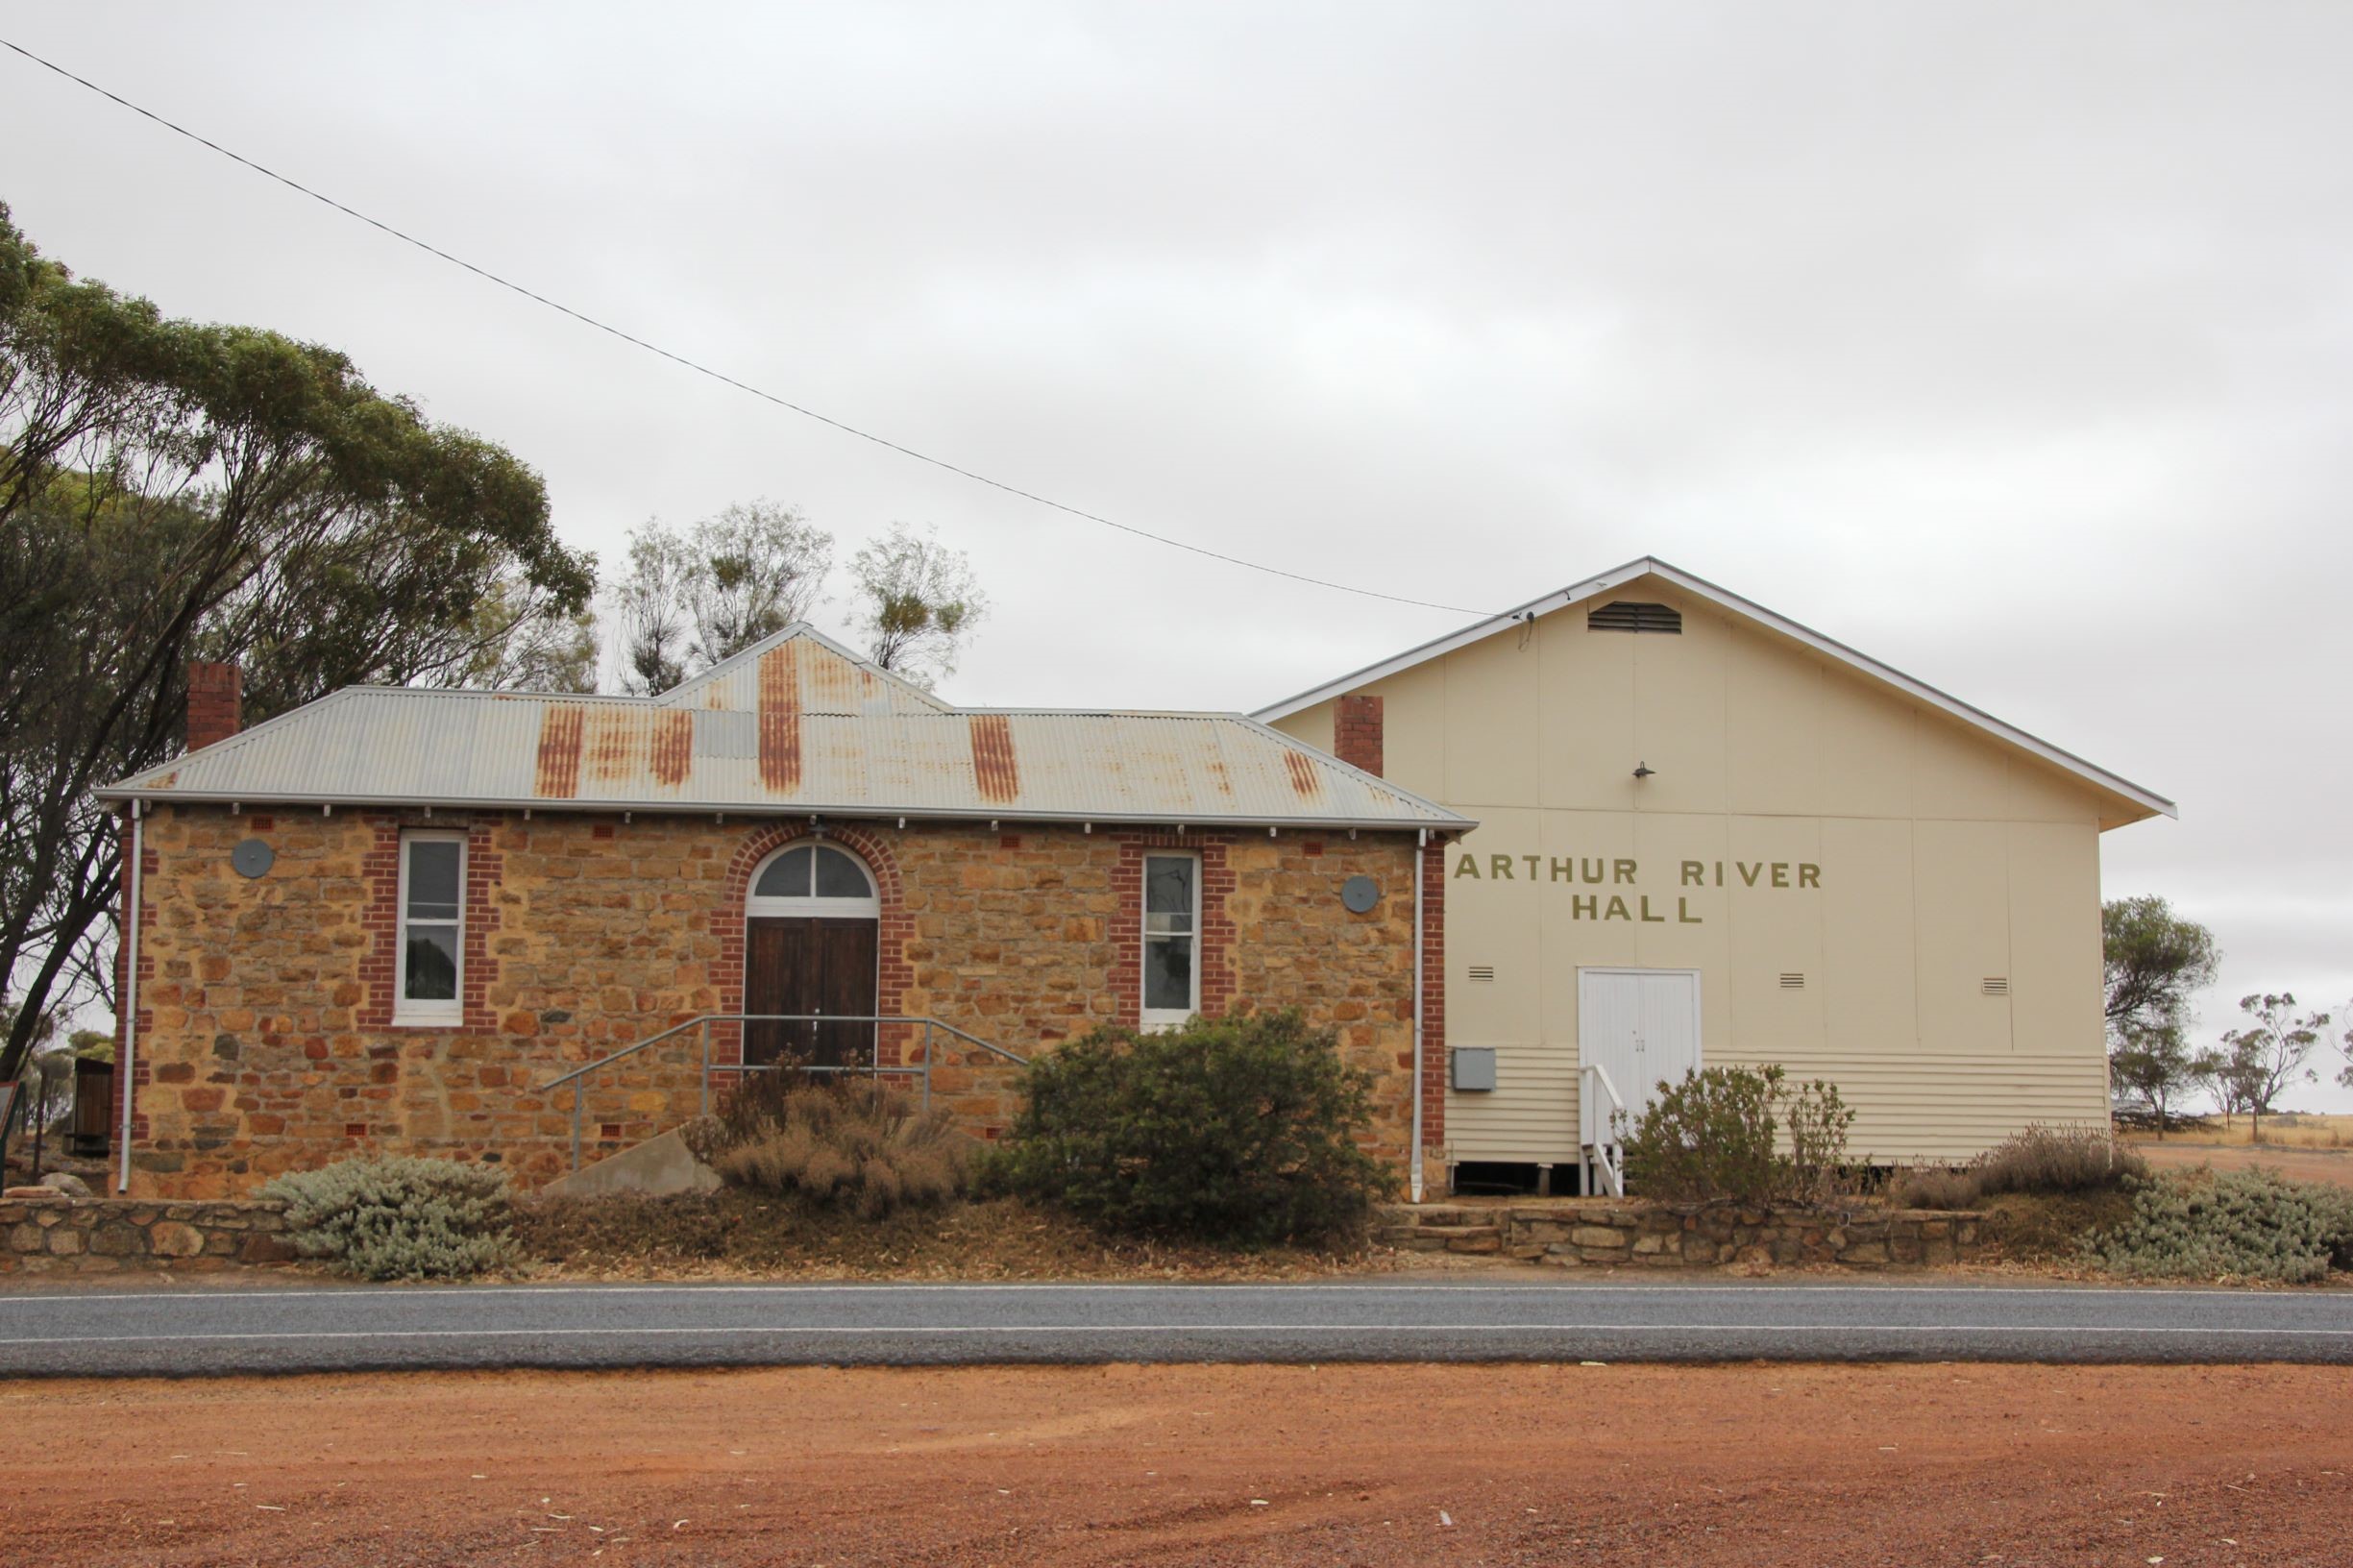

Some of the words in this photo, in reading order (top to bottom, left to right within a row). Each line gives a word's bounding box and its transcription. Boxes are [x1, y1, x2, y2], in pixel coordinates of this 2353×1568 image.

[1454, 853, 1638, 884] ARTHUR
[1680, 860, 1822, 888] RIVER
[1572, 894, 1703, 923] HALL
